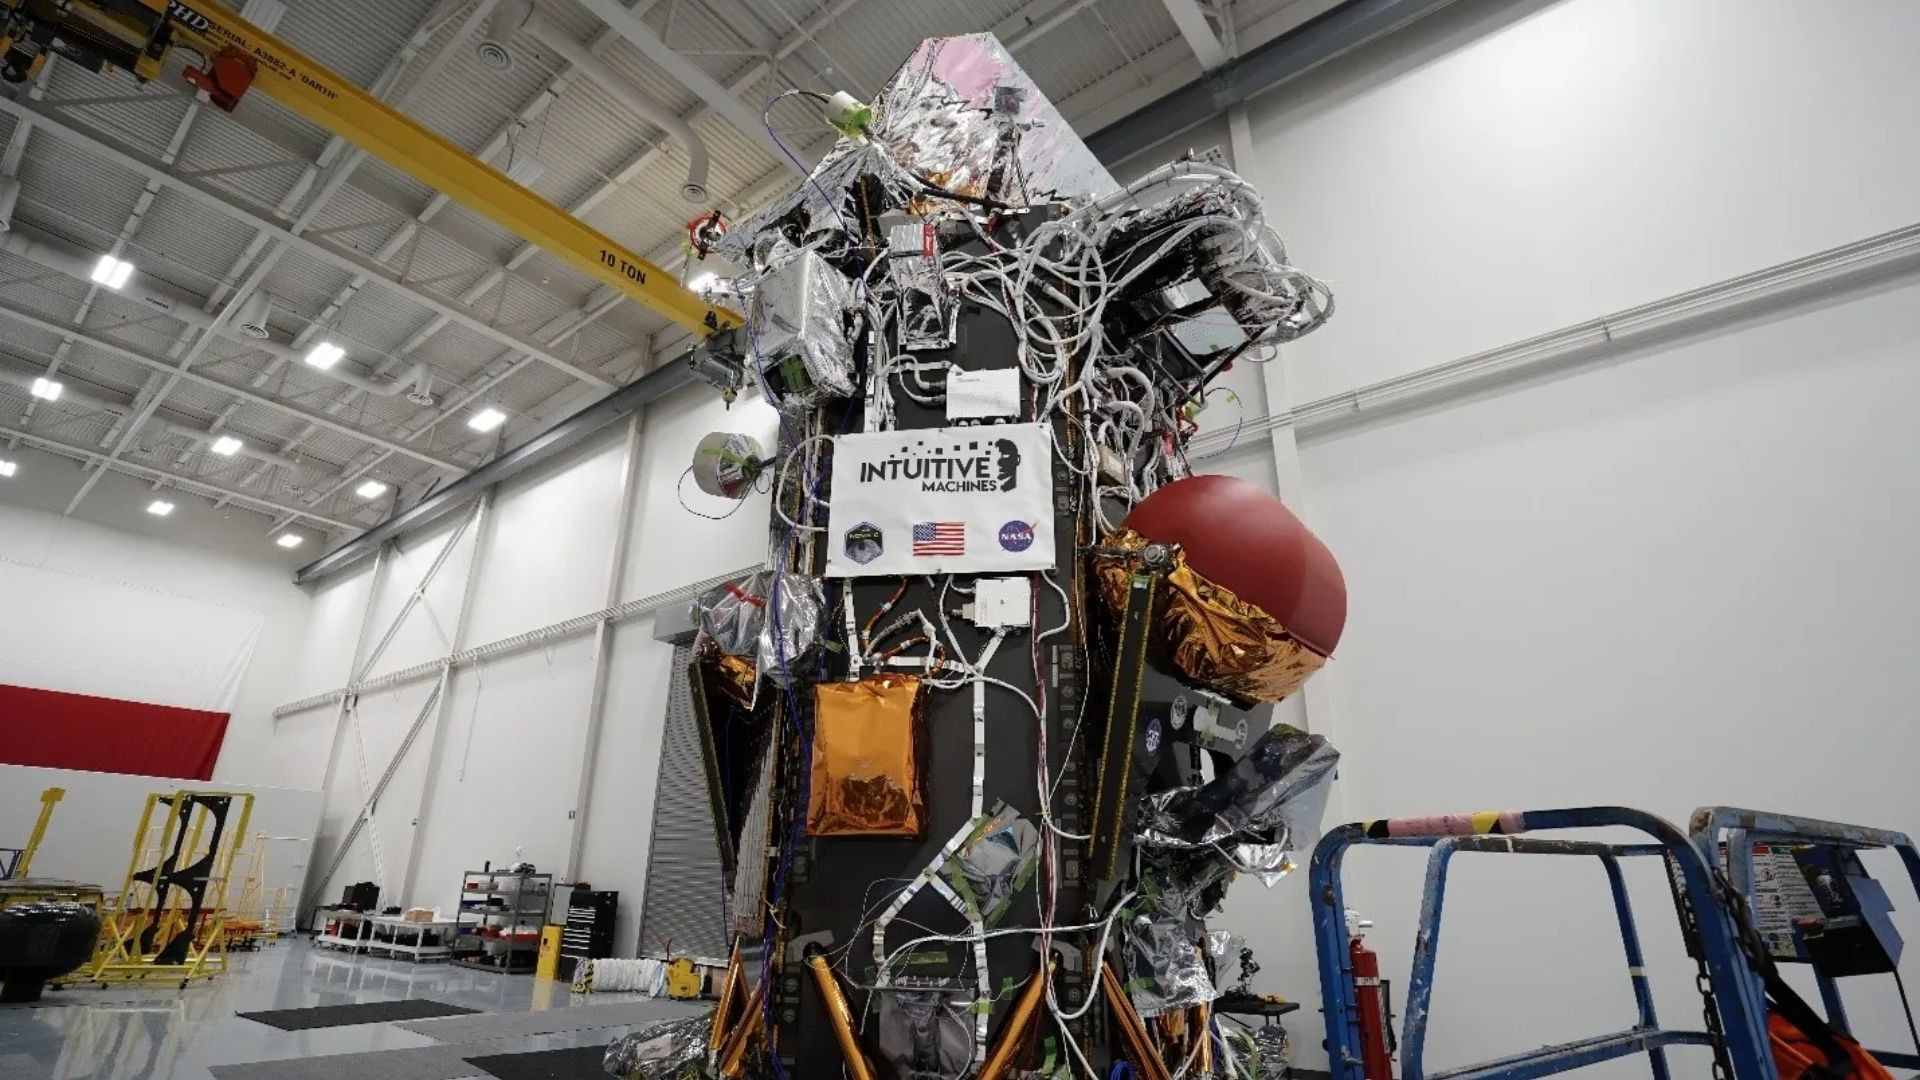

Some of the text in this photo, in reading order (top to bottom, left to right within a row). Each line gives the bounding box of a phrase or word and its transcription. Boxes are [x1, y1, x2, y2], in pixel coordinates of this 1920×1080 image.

[600, 250, 647, 284] 10 TON
[860, 457, 990, 483] INTUITIVE
[921, 480, 997, 492] MACHINES
[1001, 533, 1032, 541] NASA
